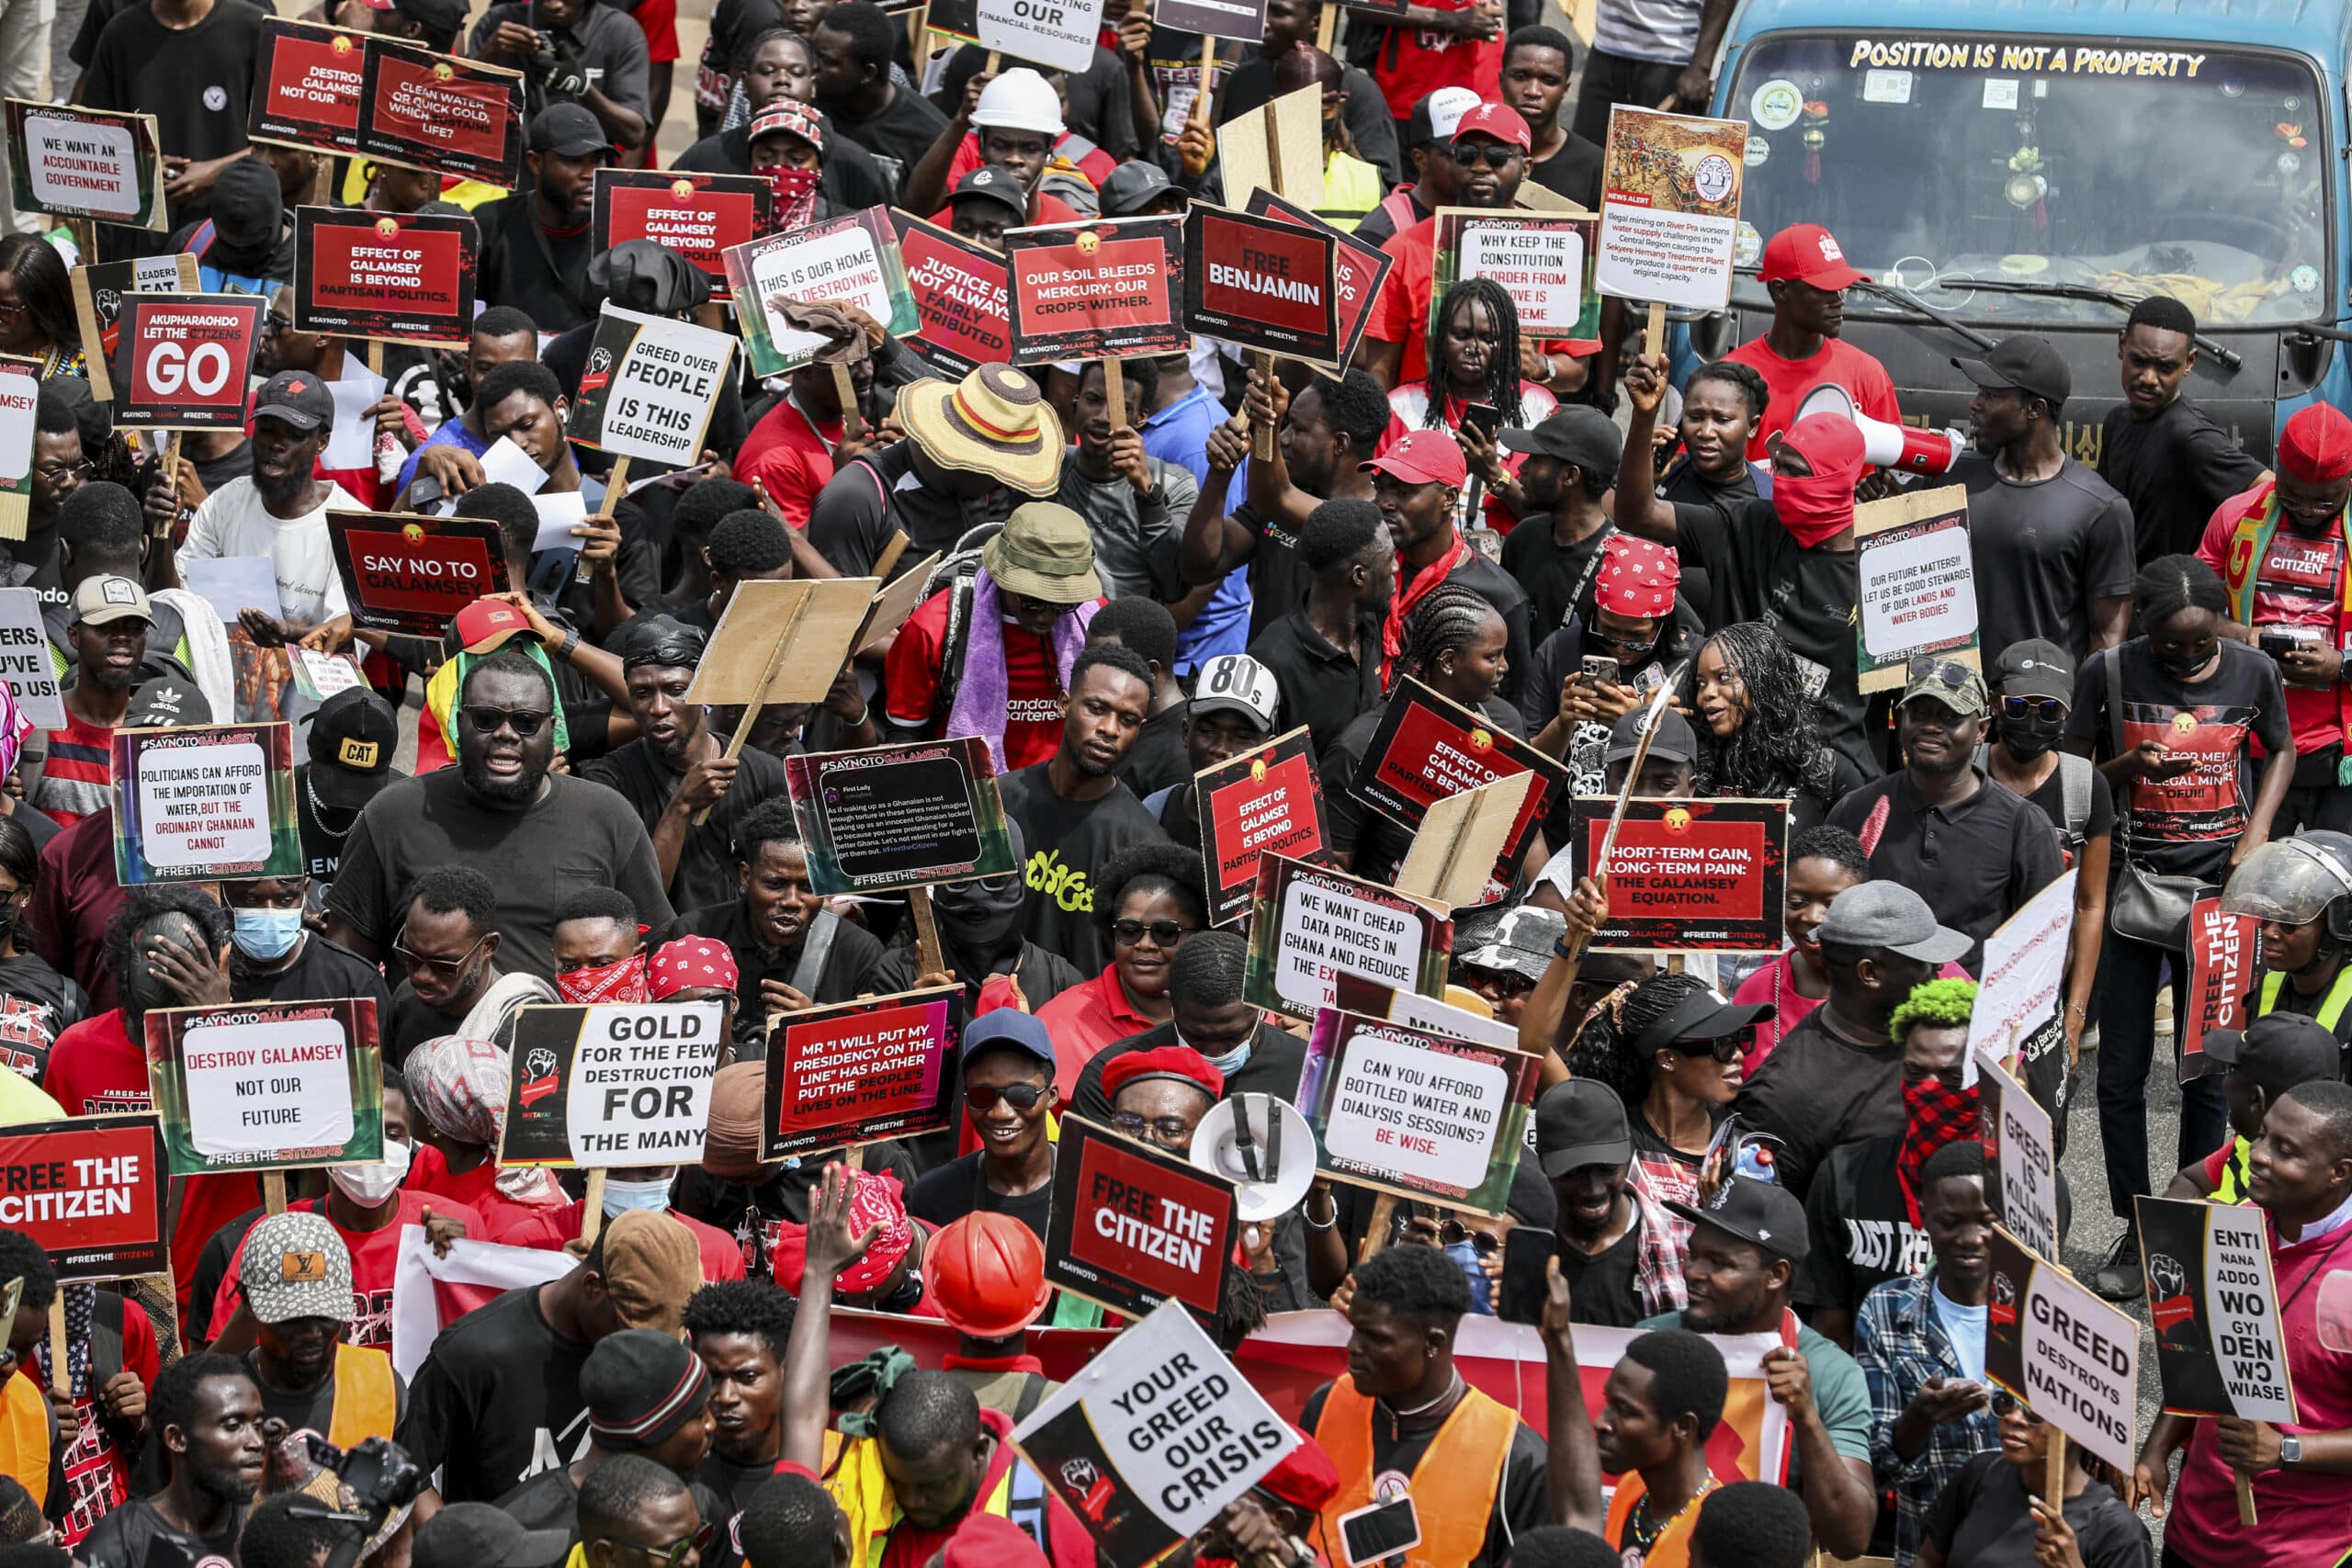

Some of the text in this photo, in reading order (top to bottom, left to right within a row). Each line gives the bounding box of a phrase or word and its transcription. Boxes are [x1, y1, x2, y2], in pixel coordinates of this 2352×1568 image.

[1014, 1, 1064, 26] OUR
[978, 11, 1091, 45] FINANCIAL RESOURCES
[1850, 40, 2206, 78] POSITION IS NOT A PROPERTY
[392, 92, 491, 123] OR QUICK GOLD,
[401, 82, 485, 110] CLEAN WATER
[423, 123, 454, 138] LIFE?
[43, 138, 116, 157] WE WANT AN
[43, 155, 120, 175] ACCOUNTABLE
[46, 173, 120, 192] GOVERNMENT
[1628, 196, 1649, 204] ALERT
[1608, 213, 1628, 222] Illegal
[1630, 217, 1654, 227] mining
[1700, 227, 1730, 235] worsens
[351, 247, 422, 259] EFFECT OF
[1480, 234, 1566, 249] WHY KEEP THE
[1619, 235, 1644, 244] Central
[1646, 240, 1670, 249] Region
[1672, 243, 1700, 254] causing
[350, 260, 423, 274] GALAMSEY
[760, 249, 874, 294] THIS IS OUR HOME
[1243, 249, 1290, 276] FREE
[1480, 253, 1564, 267] CONSTITUTION
[137, 268, 177, 280] LEADERS
[350, 274, 421, 287] IS BEYOND
[908, 266, 945, 291] NOT
[922, 256, 992, 295] JUSTICE
[1026, 264, 1156, 285] OUR SOIL BLEEDS
[1491, 271, 1566, 286] ORDER FROM
[1634, 268, 1659, 277] original
[1037, 279, 1147, 299] MERCURY; OUR
[1209, 263, 1320, 306] BENJAMIN
[926, 292, 985, 323] FAIRLY
[1035, 296, 1152, 315] CROPS WITHER.
[149, 314, 239, 327] AKUPHARAOHDO
[144, 328, 241, 339] LET THE CITIZENS
[146, 342, 231, 397] GO
[636, 342, 718, 374] GREED OVER
[625, 360, 710, 403] PEOPLE,
[617, 398, 692, 431] IS THIS
[608, 421, 691, 451] LEADERSHIP
[364, 556, 478, 579] SAY NO TO
[2270, 557, 2323, 574] CITIZEN
[2303, 549, 2330, 563] THE
[1871, 574, 1887, 588] OUR
[1888, 566, 1918, 584] FUTURE
[1892, 604, 1949, 626] WATER BODIES
[150, 703, 180, 713] adidas
[346, 744, 373, 763] CAT
[141, 764, 262, 783] POLITICIANS CAN AFFORD
[153, 783, 253, 799] THE IMPORTATION OF
[155, 818, 254, 835] ORDINARY GHANAIAN
[187, 837, 225, 851] CANNOT
[1708, 849, 1752, 863] GAIN,
[1607, 862, 1747, 875] LONG-TERM PAIN:
[1614, 877, 1738, 890] THE GALAMSEY
[1632, 892, 1720, 905] EQUATION.
[1300, 892, 1406, 935] WE WANT CHEAP
[1301, 915, 1397, 956] DATA PRICES IN
[2204, 910, 2224, 967] THE
[2219, 915, 2240, 1027] CITIZEN
[608, 1014, 702, 1042] GOLD
[187, 1044, 344, 1070] DESTROY GALAMSEY
[582, 1043, 719, 1063] FOR THE FEW
[793, 1037, 935, 1073] PRESIDENCY ON THE
[585, 1066, 715, 1083] DESTRUCTION
[839, 1054, 926, 1078] HAS RATHER
[235, 1077, 302, 1097] NOT OUR
[603, 1085, 694, 1122] FOR
[1344, 1077, 1492, 1124] BOTTLED WATER AND
[243, 1108, 302, 1126] FUTURE
[580, 1128, 707, 1152] THE MANY
[1375, 1128, 1440, 1156] BE WISE.
[2005, 1111, 2050, 1177] GREED
[73, 1156, 140, 1187] THE
[2022, 1157, 2036, 1193] IS
[0, 1187, 131, 1224] CITIZEN
[1091, 1173, 1215, 1246] FREE THE
[2006, 1171, 2053, 1241] KILLING
[1095, 1207, 1203, 1275] CITIZEN
[2214, 1228, 2261, 1250] ENTI
[2220, 1253, 2256, 1267] NANA
[2217, 1269, 2260, 1287] ADDO
[2219, 1290, 2266, 1317] WO
[2031, 1292, 2131, 1378] GREED
[2232, 1321, 2260, 1336] GYI
[2220, 1334, 2274, 1360] DEN
[2036, 1338, 2120, 1405] DESTROYS
[1111, 1351, 1199, 1417] YOUR
[2227, 1381, 2286, 1402] WIASE
[1127, 1372, 1230, 1453] GREED
[2028, 1363, 2128, 1445] NATIONS
[1164, 1415, 1234, 1470] OUR
[1160, 1420, 1283, 1515] CRISIS
